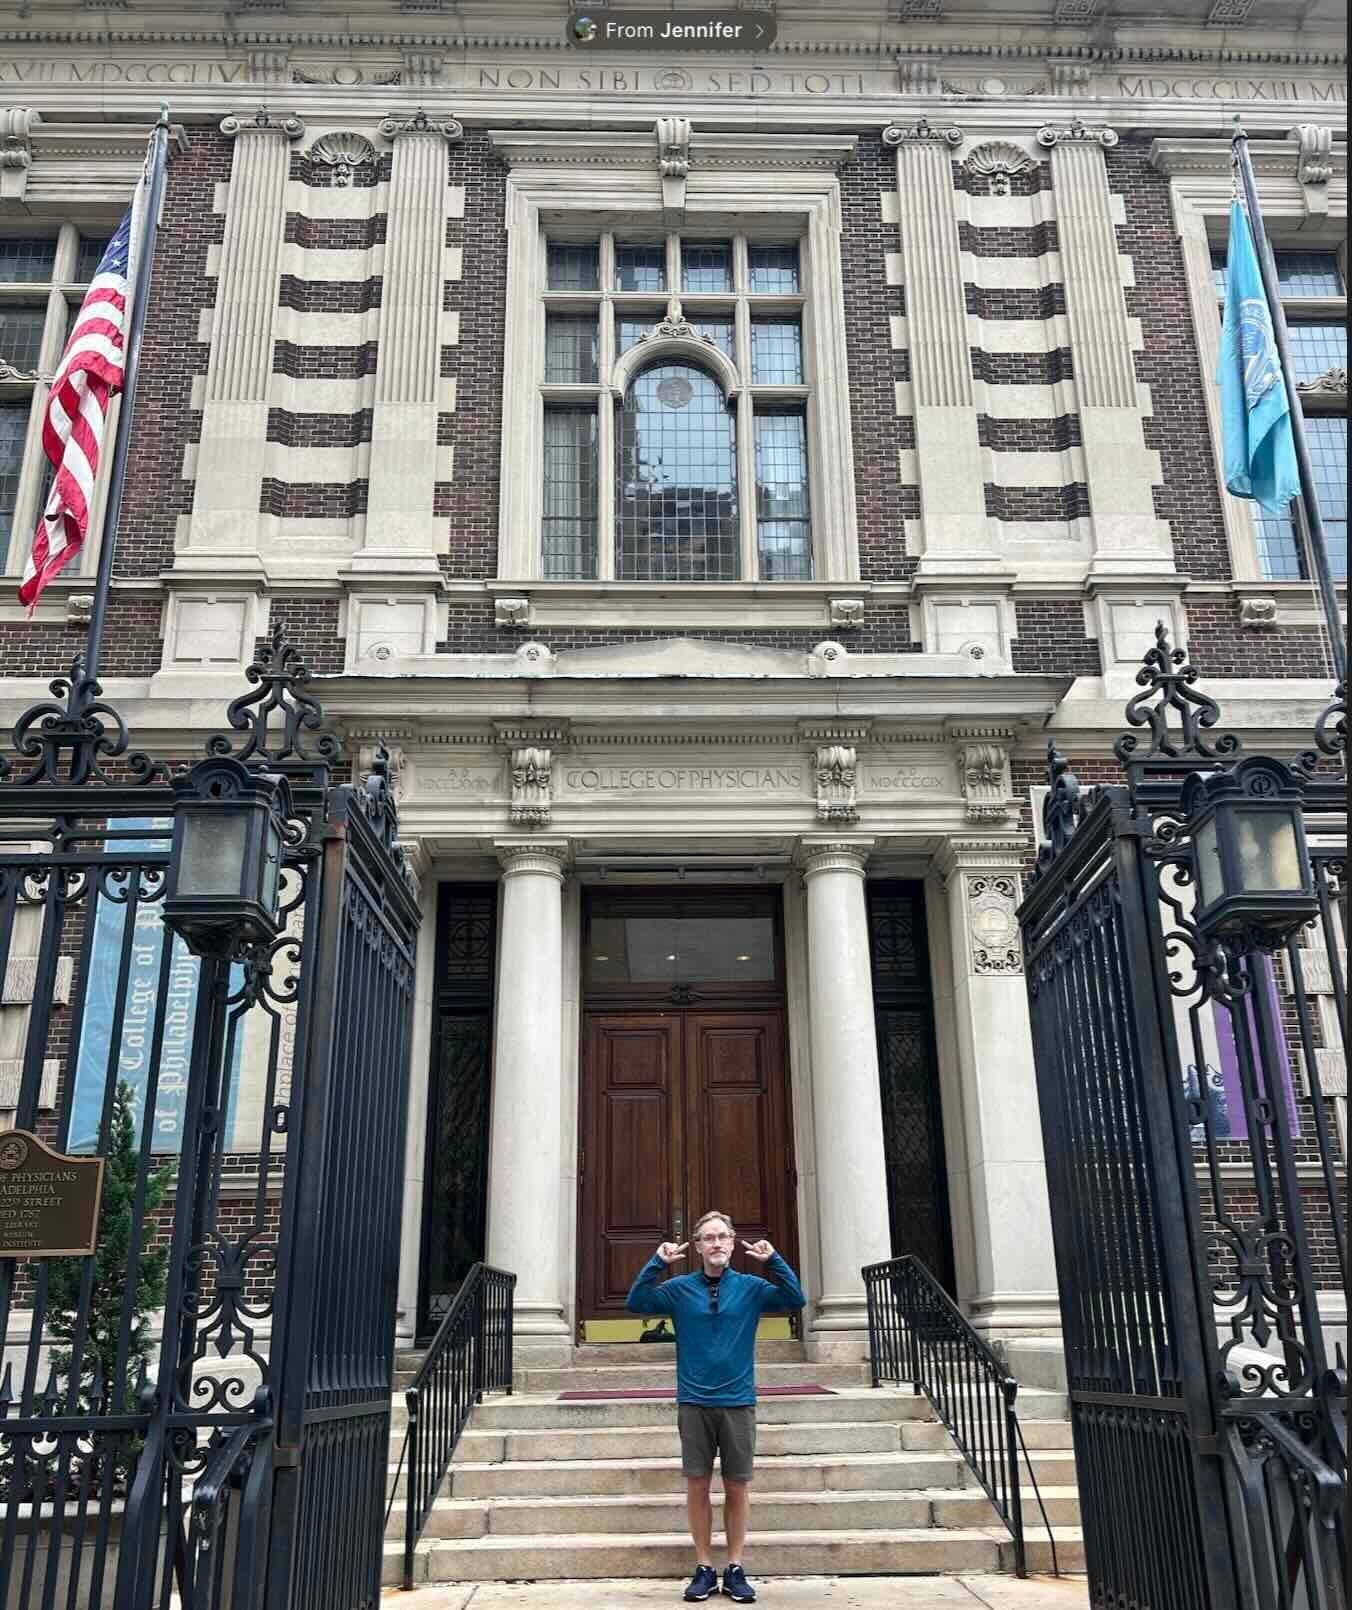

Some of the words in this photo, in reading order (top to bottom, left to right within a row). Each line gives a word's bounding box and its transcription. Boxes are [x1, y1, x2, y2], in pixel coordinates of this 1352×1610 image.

[479, 68, 562, 89] NON
[578, 69, 641, 91] SIBI
[708, 71, 772, 93] SED
[782, 72, 864, 94] TOTI
[566, 769, 657, 789] COLLEGE
[658, 769, 686, 789] OF
[687, 768, 801, 789] PHYSICIANS
[132, 942, 154, 966] of
[119, 976, 155, 1071] College
[154, 1107, 178, 1132] of
[12, 1171, 77, 1182] PHYSICIANS
[23, 1197, 64, 1207] STREET
